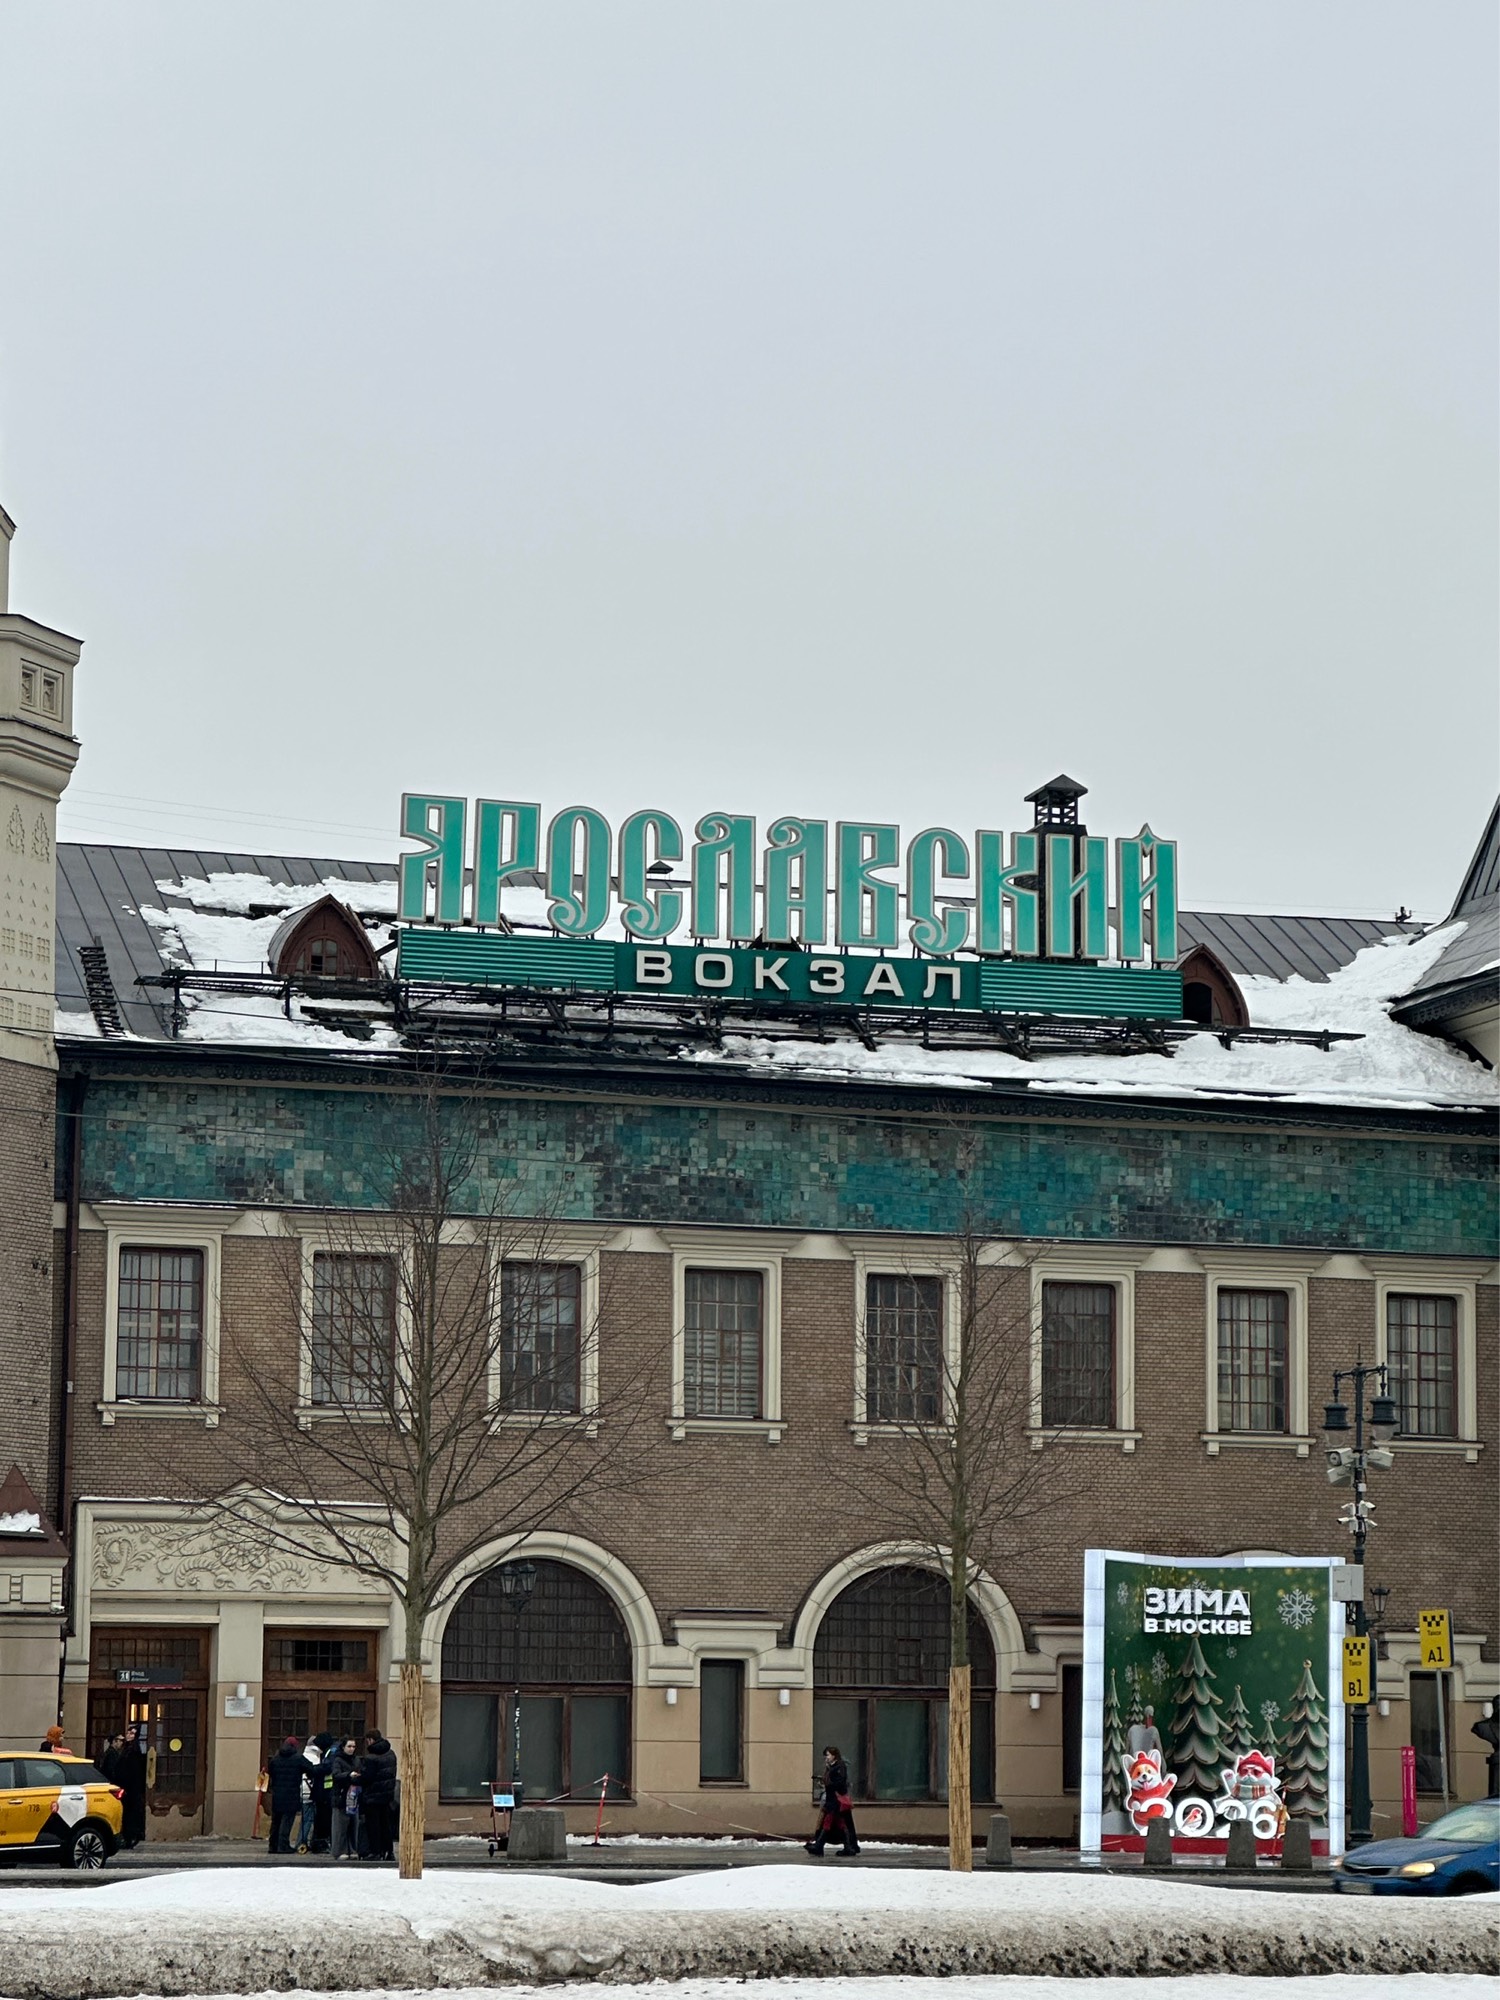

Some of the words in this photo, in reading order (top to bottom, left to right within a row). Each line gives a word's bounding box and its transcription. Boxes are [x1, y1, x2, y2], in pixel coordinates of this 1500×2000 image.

[398, 793, 1179, 964] ЯРОСЛАВСКИЙ
[636, 949, 961, 1000] ВОКЗАЛ
[1144, 1587, 1251, 1616] ЗИМА
[1144, 1618, 1159, 1633] В
[1165, 1618, 1252, 1635] МОСКВЕ
[1427, 1646, 1445, 1663] A1
[1348, 1678, 1364, 1697] B1
